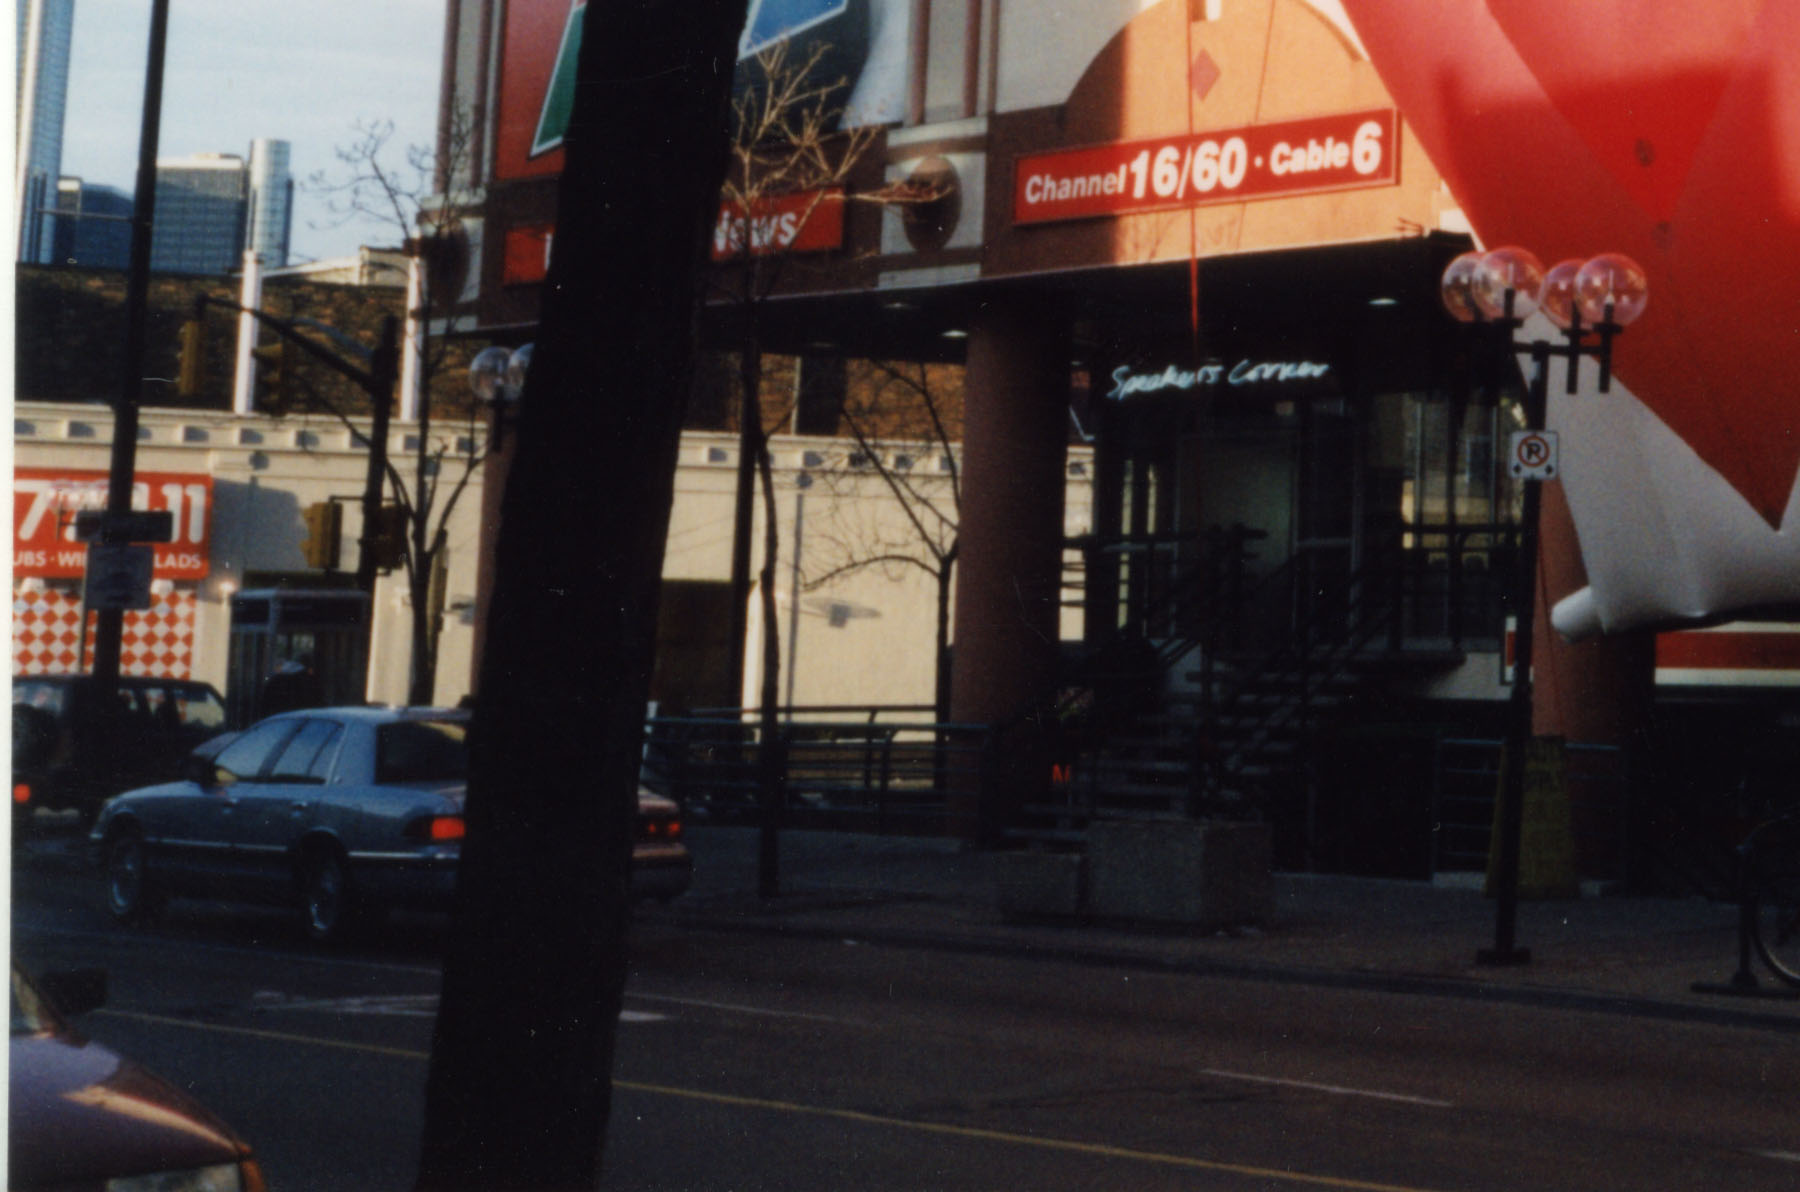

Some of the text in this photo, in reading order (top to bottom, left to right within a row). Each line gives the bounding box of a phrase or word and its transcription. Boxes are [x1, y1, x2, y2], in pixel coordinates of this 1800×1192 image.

[1025, 121, 1383, 204] Channel 16/60 Cable 6
[1228, 359, 1330, 385] Corner
